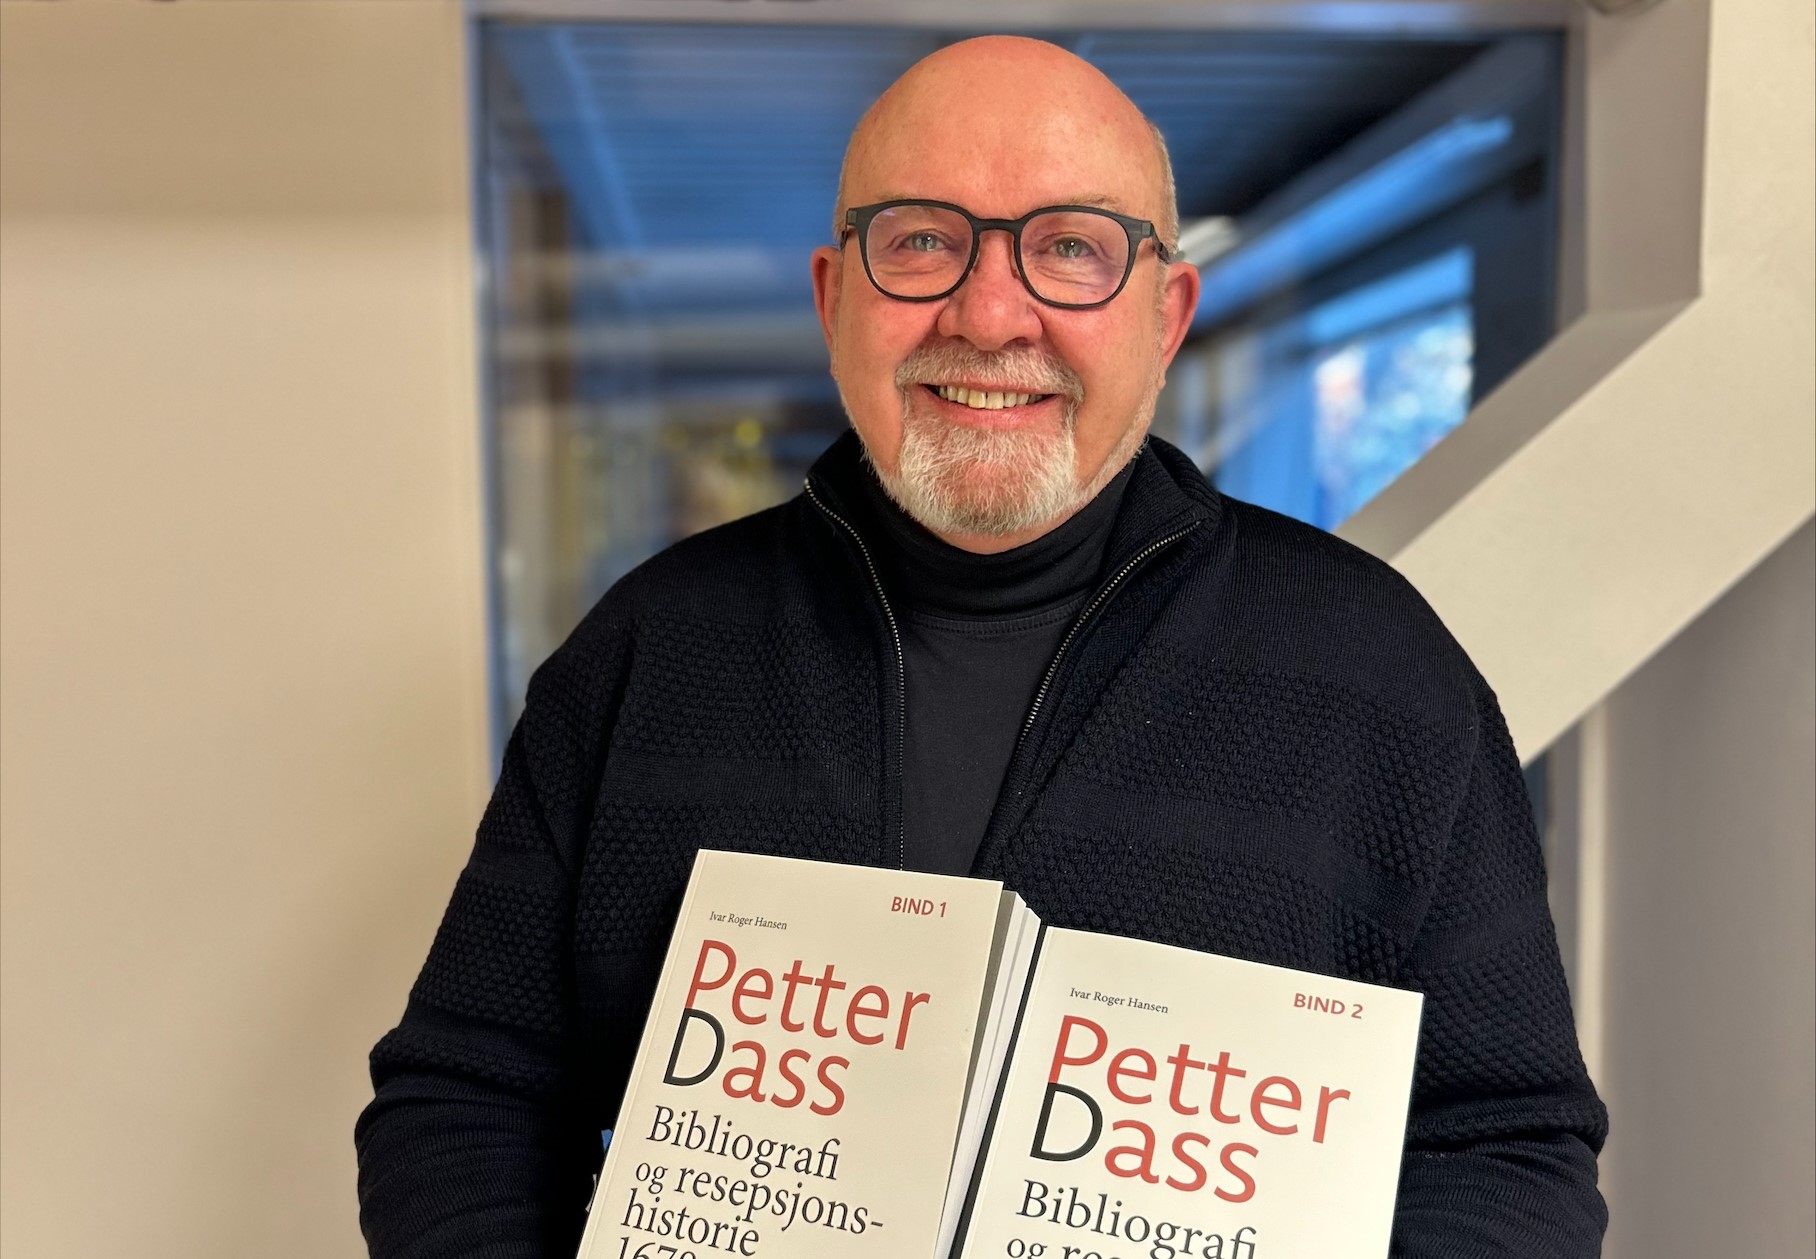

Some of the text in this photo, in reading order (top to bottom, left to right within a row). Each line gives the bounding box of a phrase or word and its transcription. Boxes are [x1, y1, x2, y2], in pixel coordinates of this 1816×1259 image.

[709, 911, 788, 930] Ivar Roger Hansen
[891, 896, 947, 918] BIND 1
[684, 939, 931, 1050] Petter
[1069, 987, 1169, 1014] Ivar Roger Hansen
[1293, 992, 1364, 1020] BIND 2
[662, 1008, 850, 1116] Dass
[1048, 1015, 1351, 1144] Petter
[646, 1104, 841, 1181] Bibliografi
[1029, 1082, 1259, 1203] Dass
[620, 1188, 760, 1257] historie
[635, 1162, 884, 1235] og resepsjons-
[1015, 1179, 1257, 1259] Bibliografi
